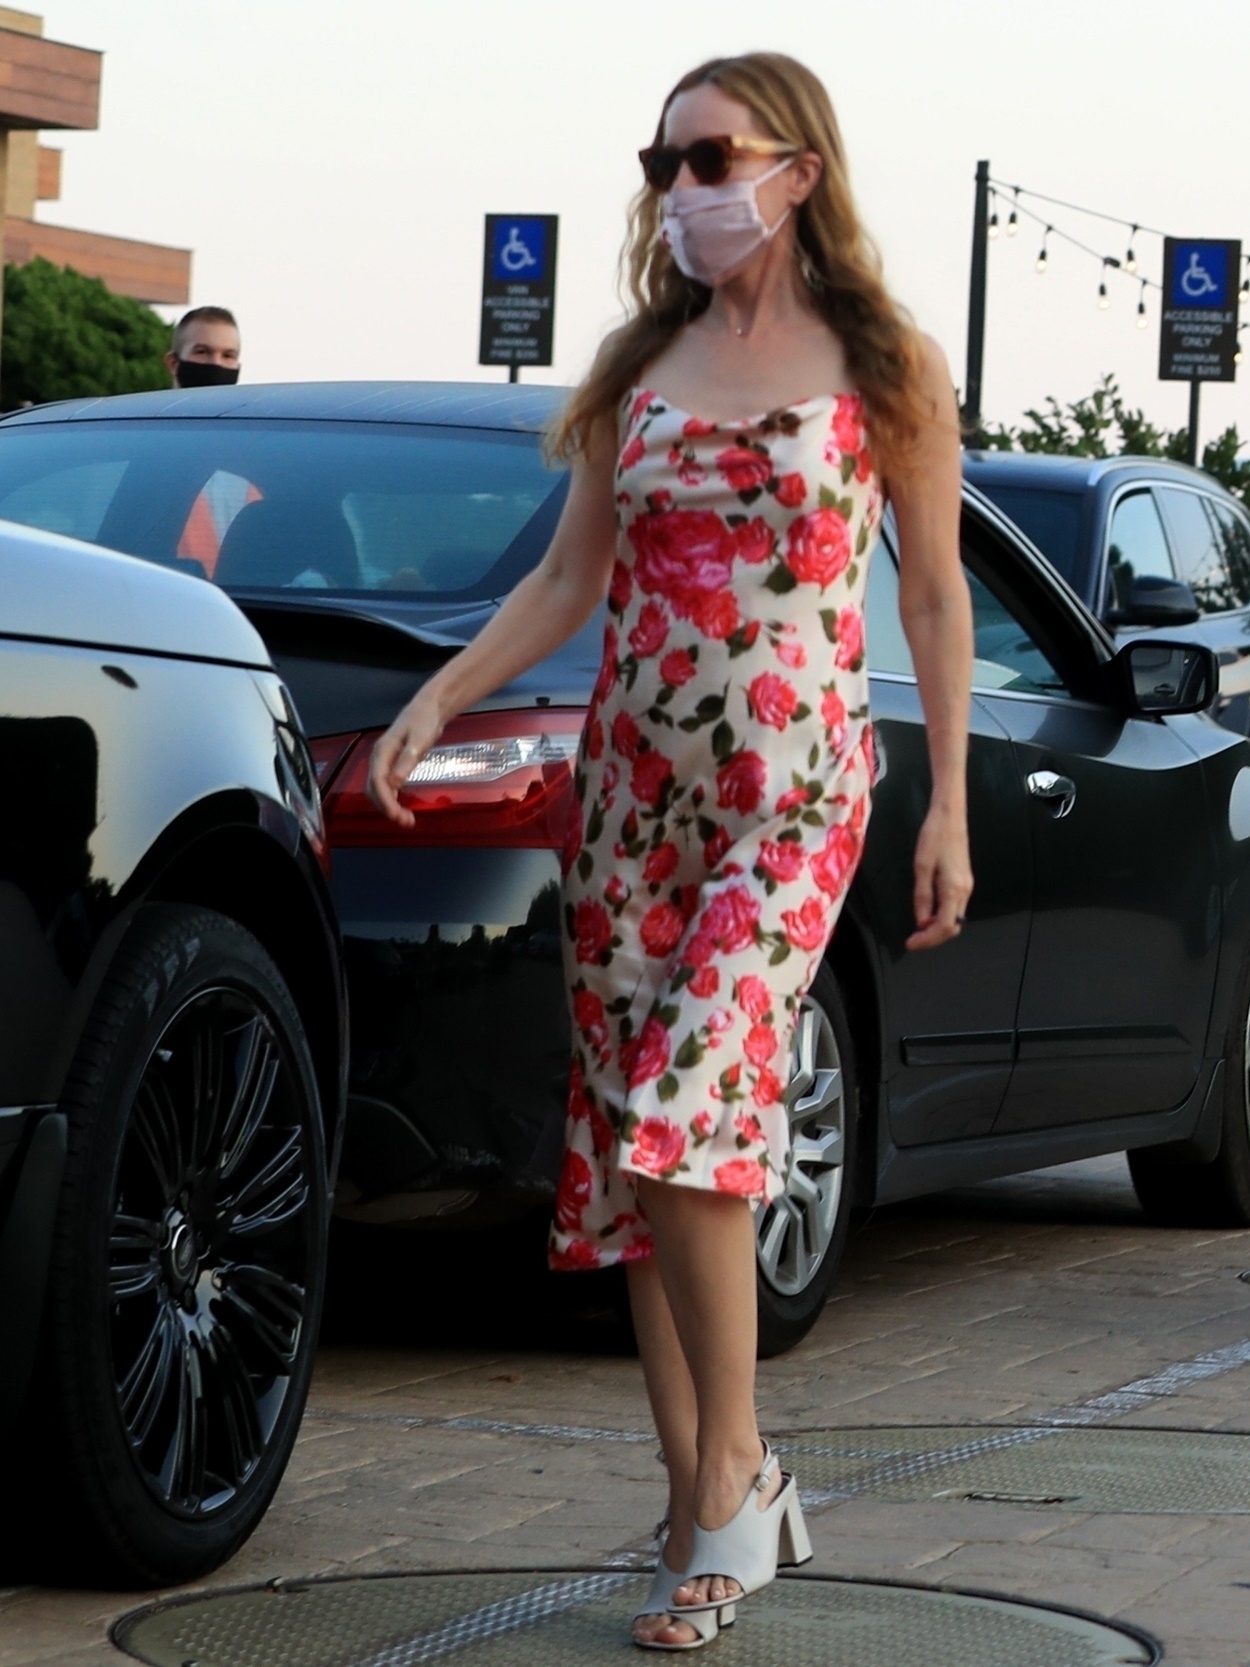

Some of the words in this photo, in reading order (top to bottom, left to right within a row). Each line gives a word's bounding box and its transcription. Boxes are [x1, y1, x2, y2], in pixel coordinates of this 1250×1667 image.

[485, 296, 550, 308] ACCESSIBLE
[492, 309, 541, 321] PARKING
[1164, 310, 1234, 323] ACCESSIBLE
[1172, 322, 1223, 335] PARKING
[1181, 335, 1213, 348] ONLY
